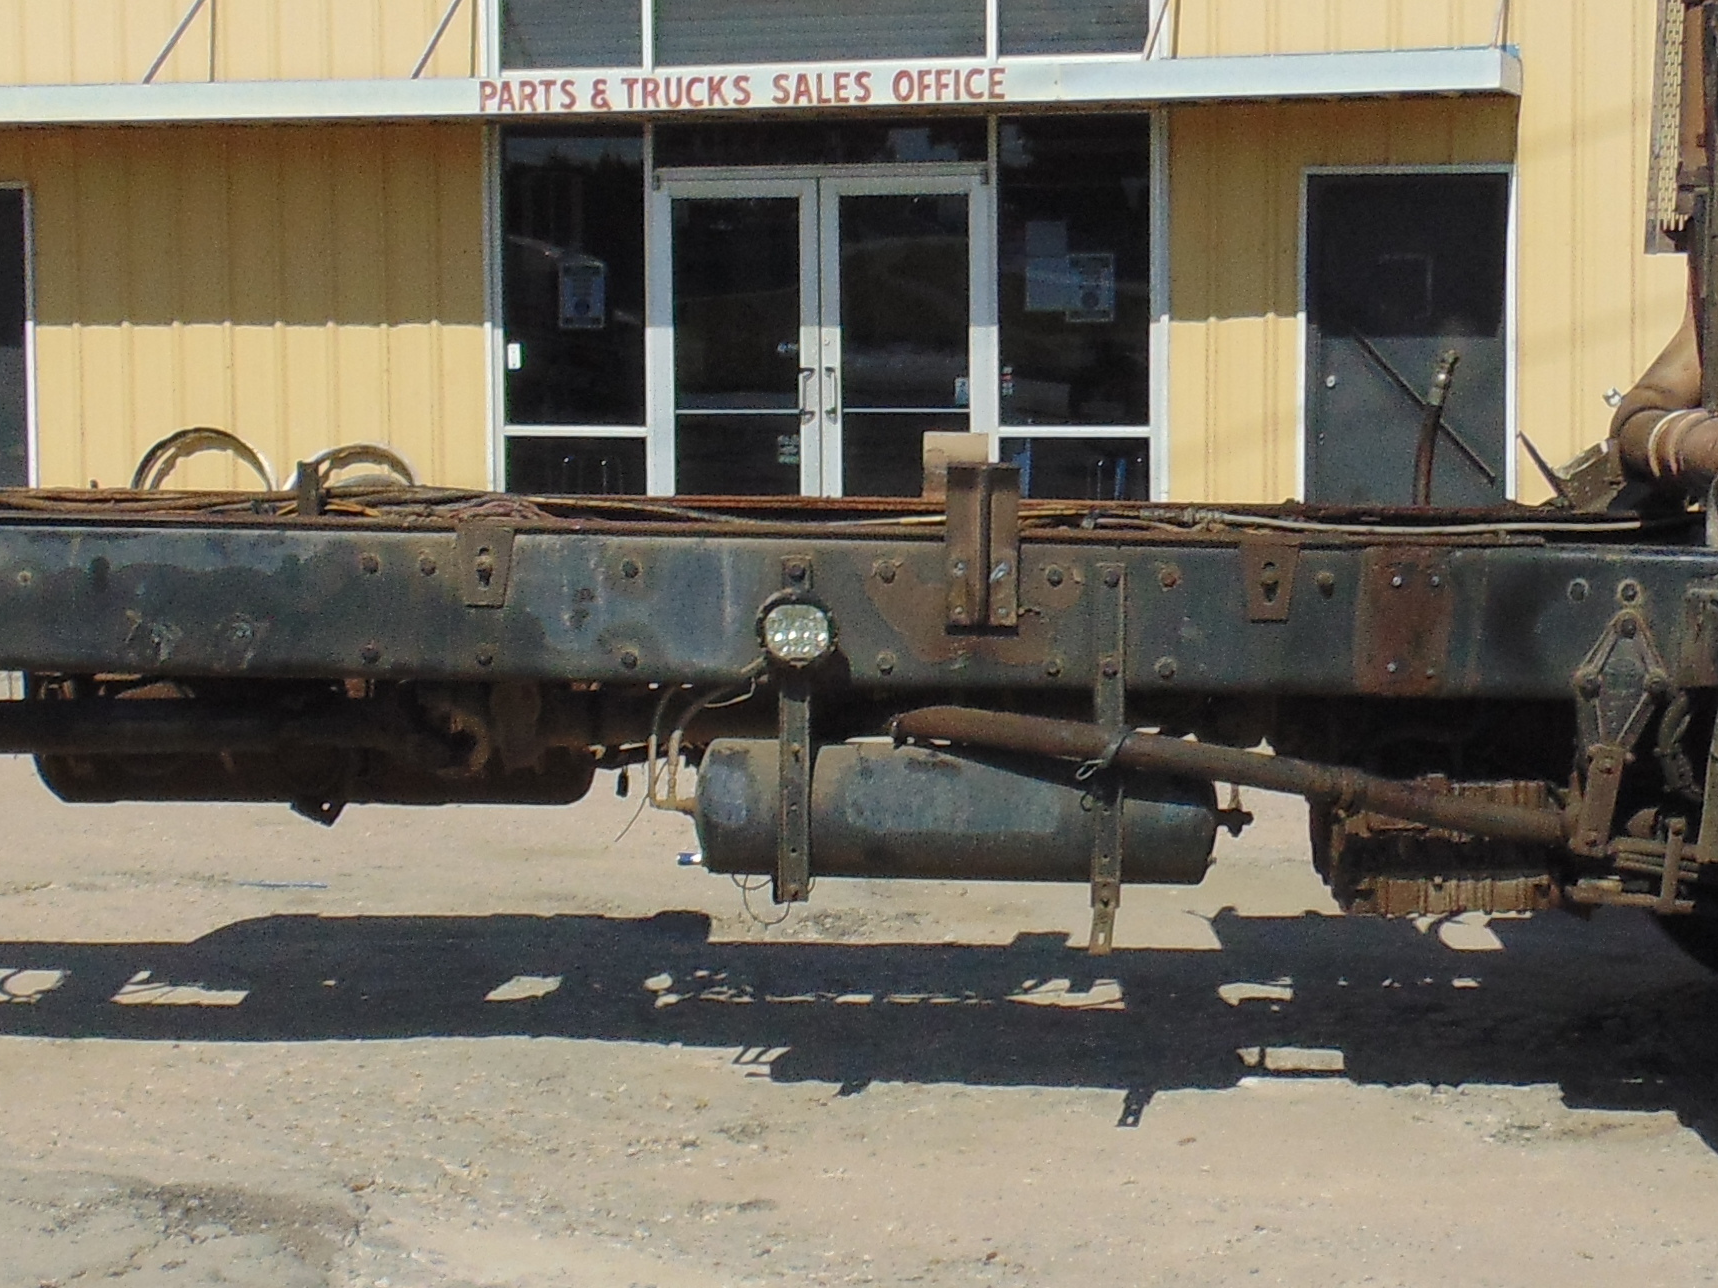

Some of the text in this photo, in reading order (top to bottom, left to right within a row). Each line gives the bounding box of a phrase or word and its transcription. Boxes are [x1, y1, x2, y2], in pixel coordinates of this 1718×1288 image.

[479, 66, 1007, 112] PARTS & TRUCKS SALES OFFICE
